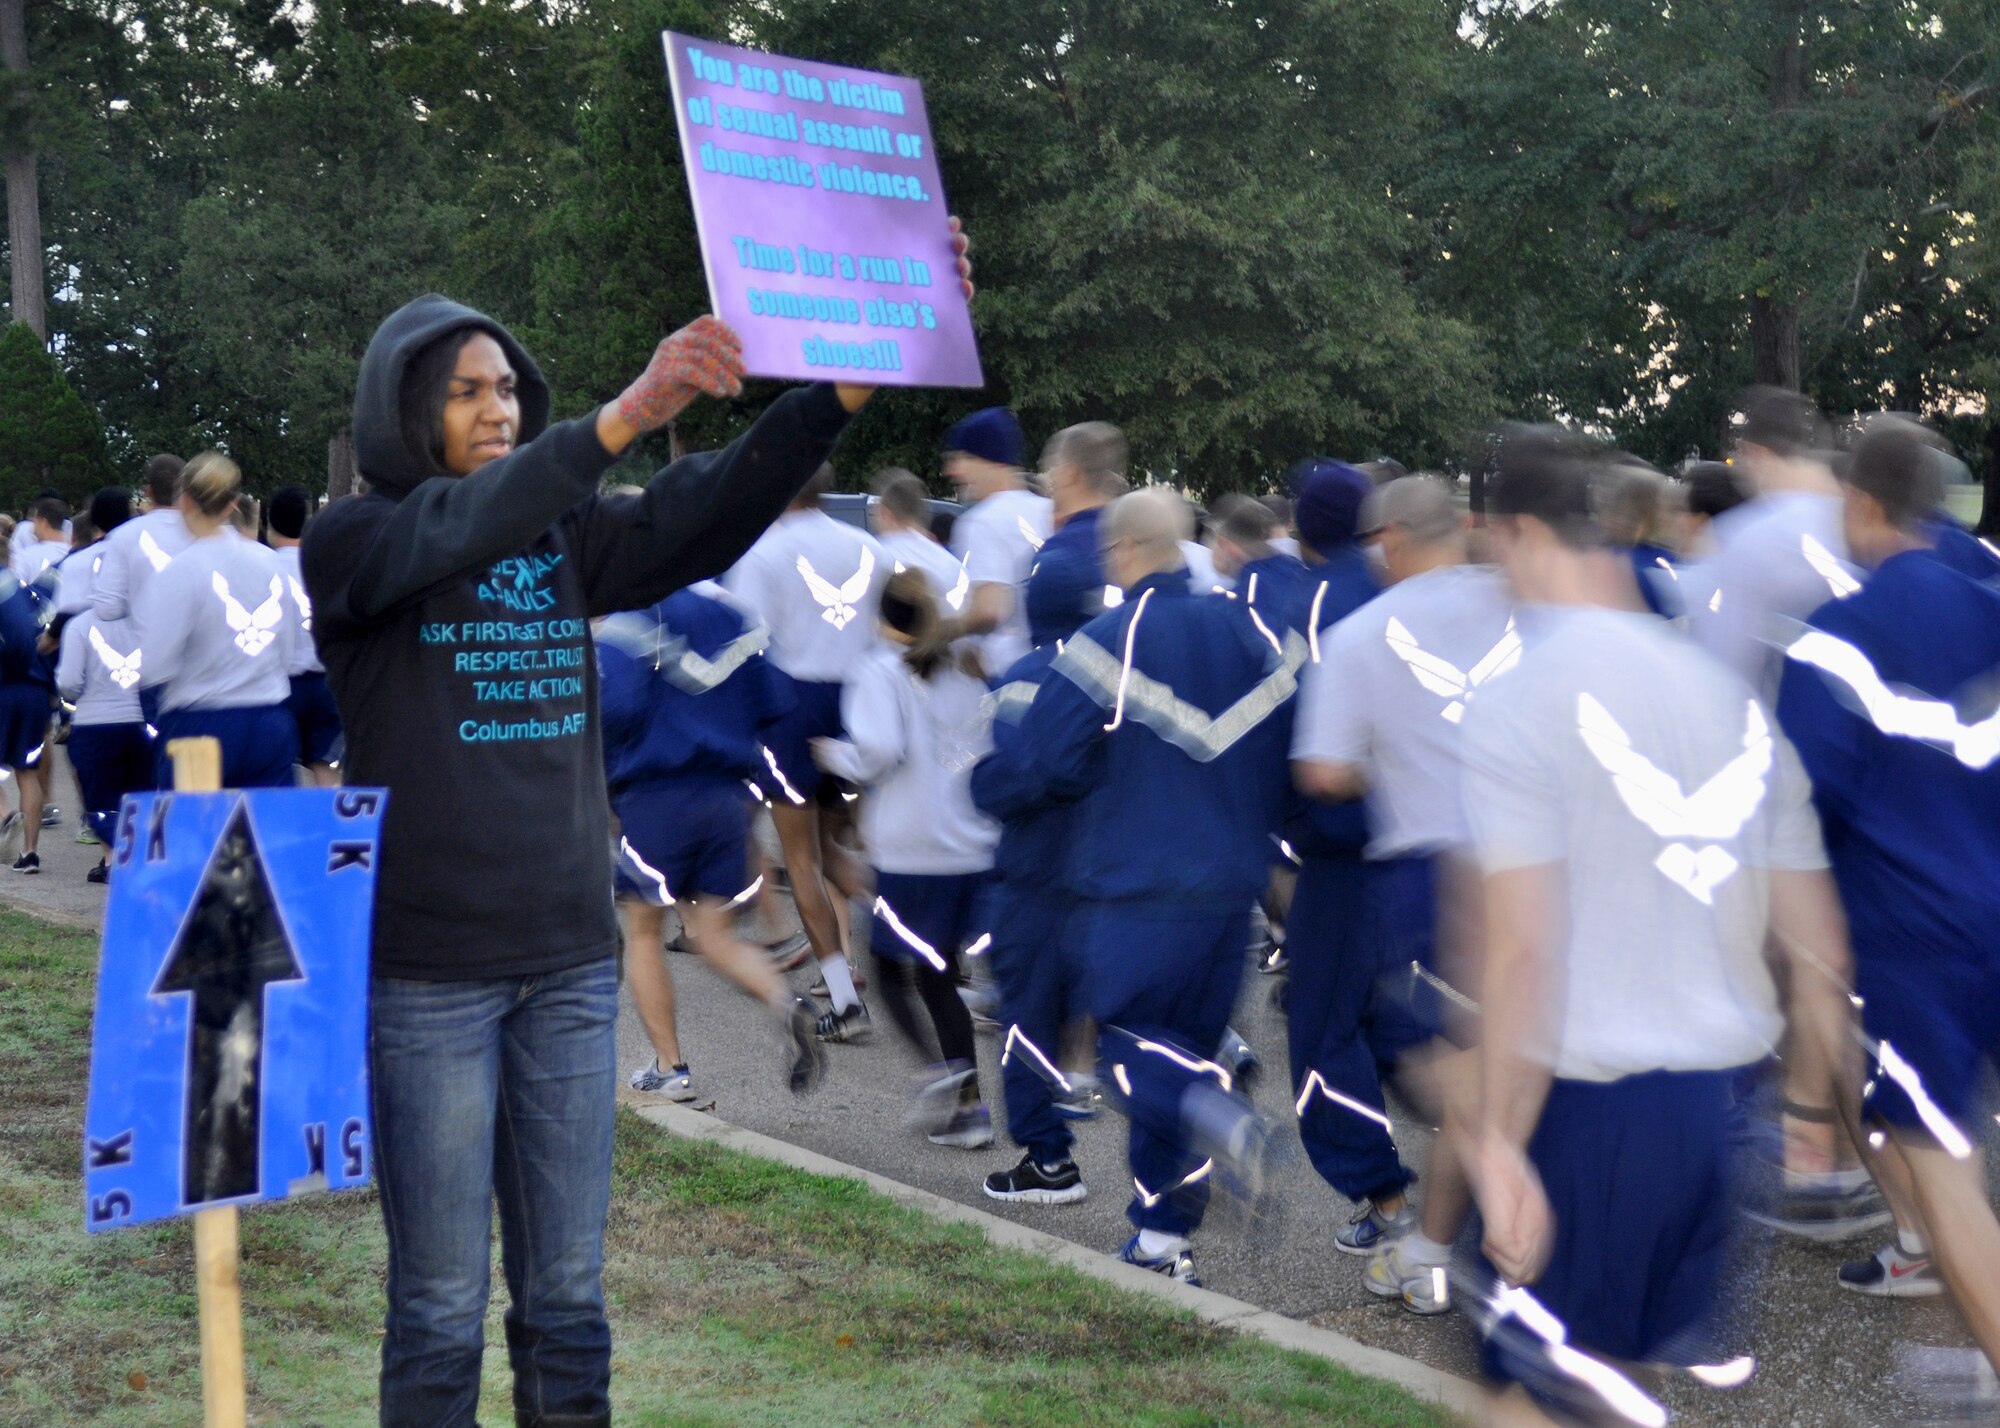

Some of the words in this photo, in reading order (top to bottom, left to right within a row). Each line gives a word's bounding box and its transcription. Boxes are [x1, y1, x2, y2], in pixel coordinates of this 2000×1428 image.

[687, 47, 734, 86] You
[738, 63, 780, 95] are
[782, 69, 824, 103] the
[827, 79, 905, 116] victim
[687, 96, 713, 127] of
[717, 103, 799, 143] sexual
[802, 119, 894, 156] assault
[896, 132, 922, 159] or
[699, 141, 814, 188] domestic
[817, 161, 930, 202] violence.
[732, 235, 796, 275] Time
[798, 244, 835, 278] for
[838, 253, 856, 281] a
[859, 254, 903, 285] run
[905, 256, 932, 287] in
[747, 287, 860, 324] someone
[863, 297, 937, 330] else's
[420, 623, 457, 642] ASK
[473, 681, 525, 701] TAKE
[529, 677, 582, 699] ACTION
[459, 718, 559, 743] Columbus
